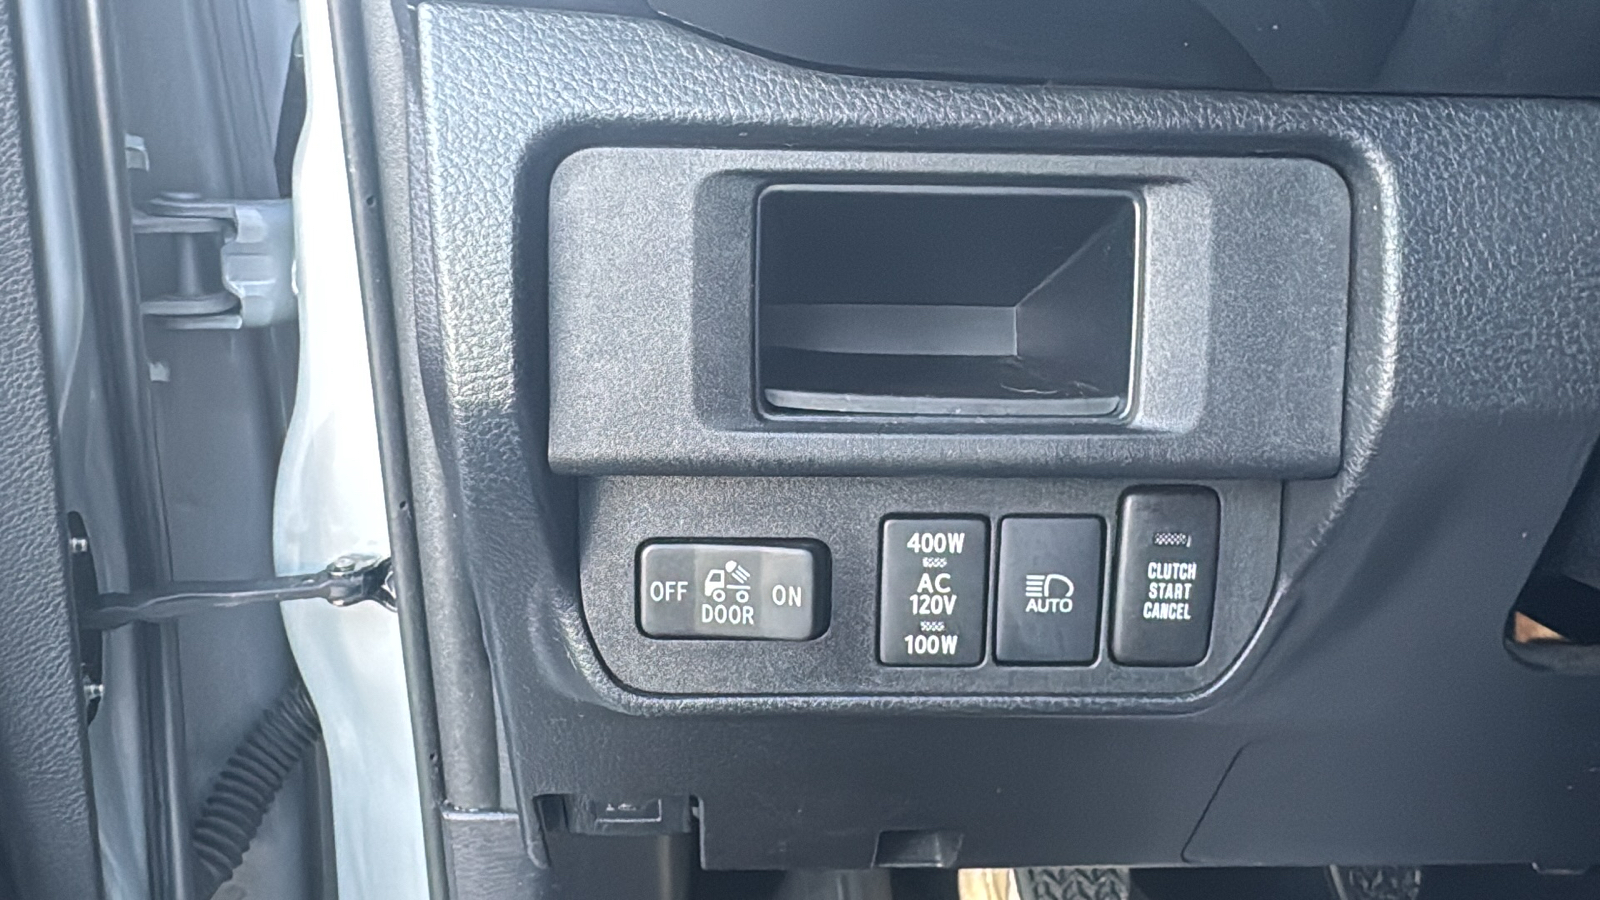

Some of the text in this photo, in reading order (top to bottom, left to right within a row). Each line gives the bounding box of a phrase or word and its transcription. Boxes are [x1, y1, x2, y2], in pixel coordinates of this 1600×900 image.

[907, 532, 965, 554] 400W
[1147, 561, 1197, 581] CLUTCH
[650, 581, 689, 602] OFF
[916, 573, 952, 594] AC
[1148, 582, 1192, 600] START
[772, 584, 802, 608] ON
[909, 594, 958, 615] 120V
[1025, 598, 1073, 613] AUTO
[701, 603, 754, 626] DOOR
[1142, 601, 1192, 621] CANCEL
[904, 634, 958, 655] 100W
